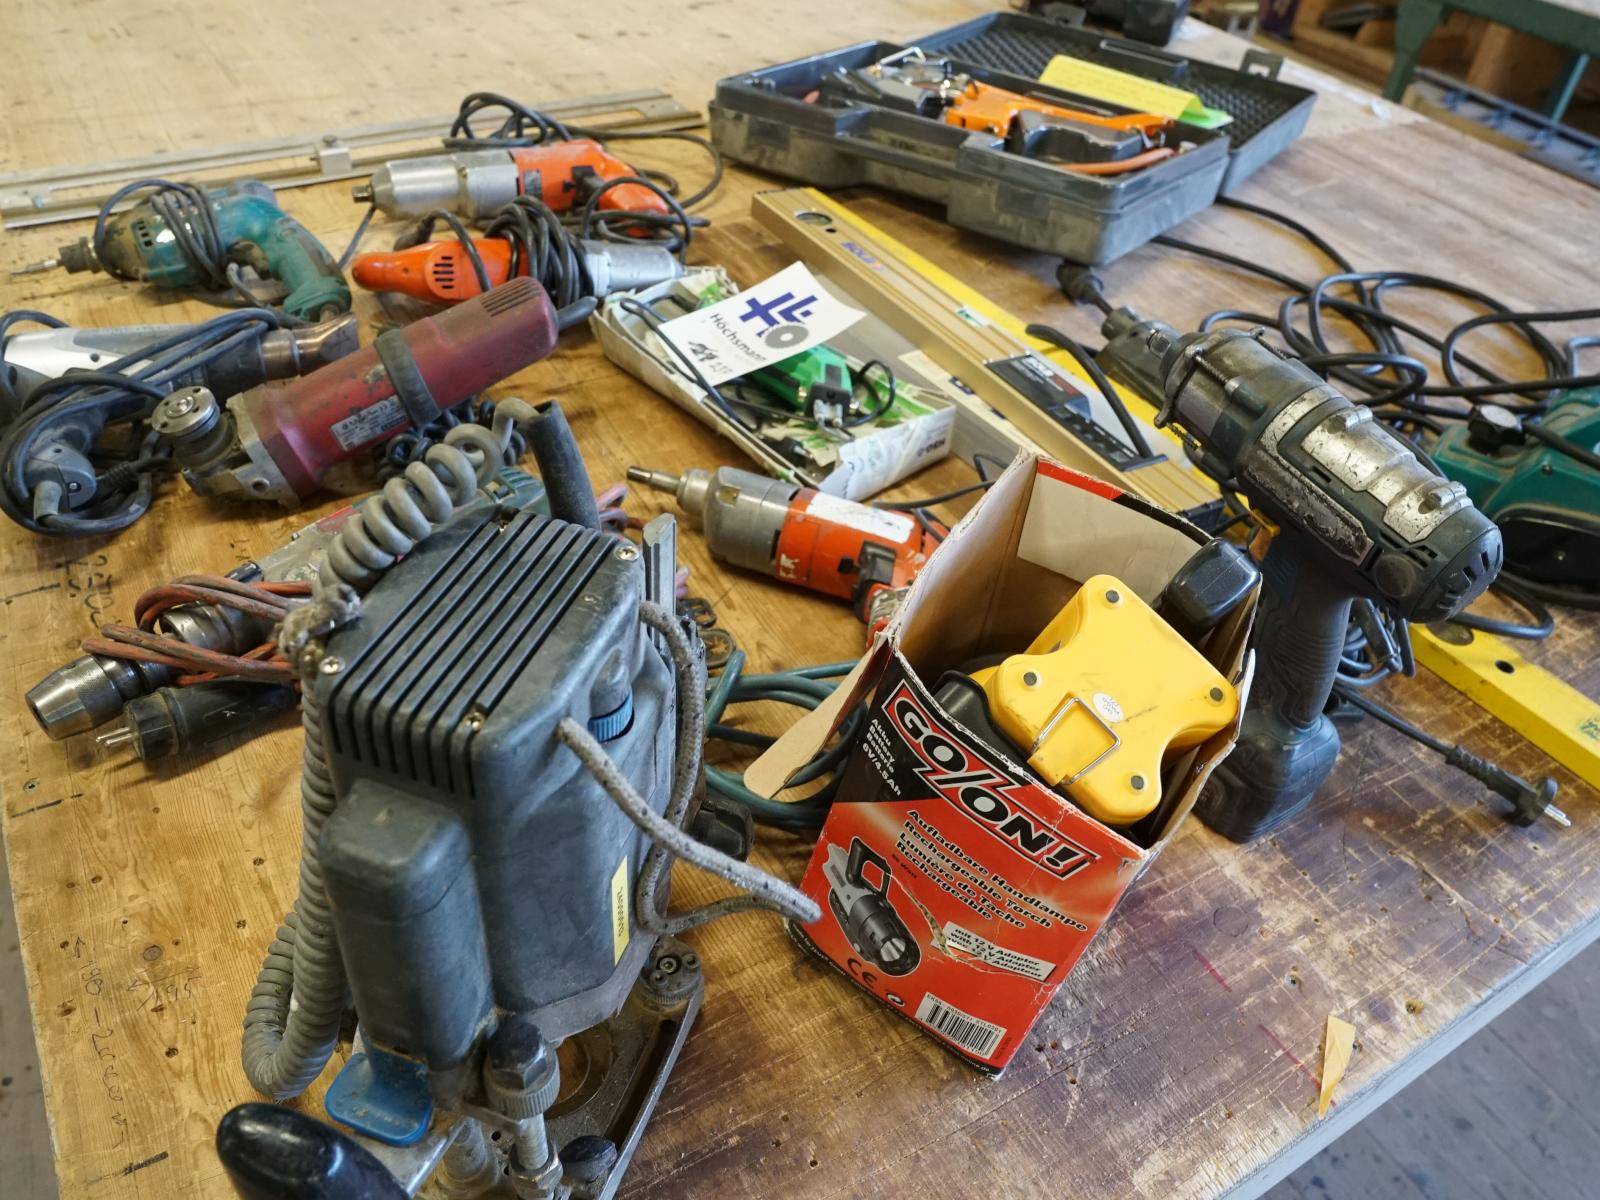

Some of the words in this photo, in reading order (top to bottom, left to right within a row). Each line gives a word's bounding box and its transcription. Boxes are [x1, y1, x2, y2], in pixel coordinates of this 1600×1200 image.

[709, 312, 767, 362] Höchsmann
[866, 732, 895, 774] Batterie
[868, 725, 895, 764] Battery
[871, 718, 892, 747] Akku
[895, 841, 993, 921] Rechargeable
[899, 831, 954, 881] Lumière
[957, 882, 976, 898] de
[979, 895, 1026, 930] Tache
[903, 820, 1003, 901] Rechargeable
[1006, 899, 1053, 929] Torch
[908, 809, 989, 876] Aufladbare
[992, 875, 1088, 932] Handlampe
[950, 932, 972, 945] with
[997, 955, 1040, 972] Adapter
[954, 927, 972, 940] mit
[996, 949, 1040, 966] Adapter
[993, 960, 1042, 977] Adapteur
